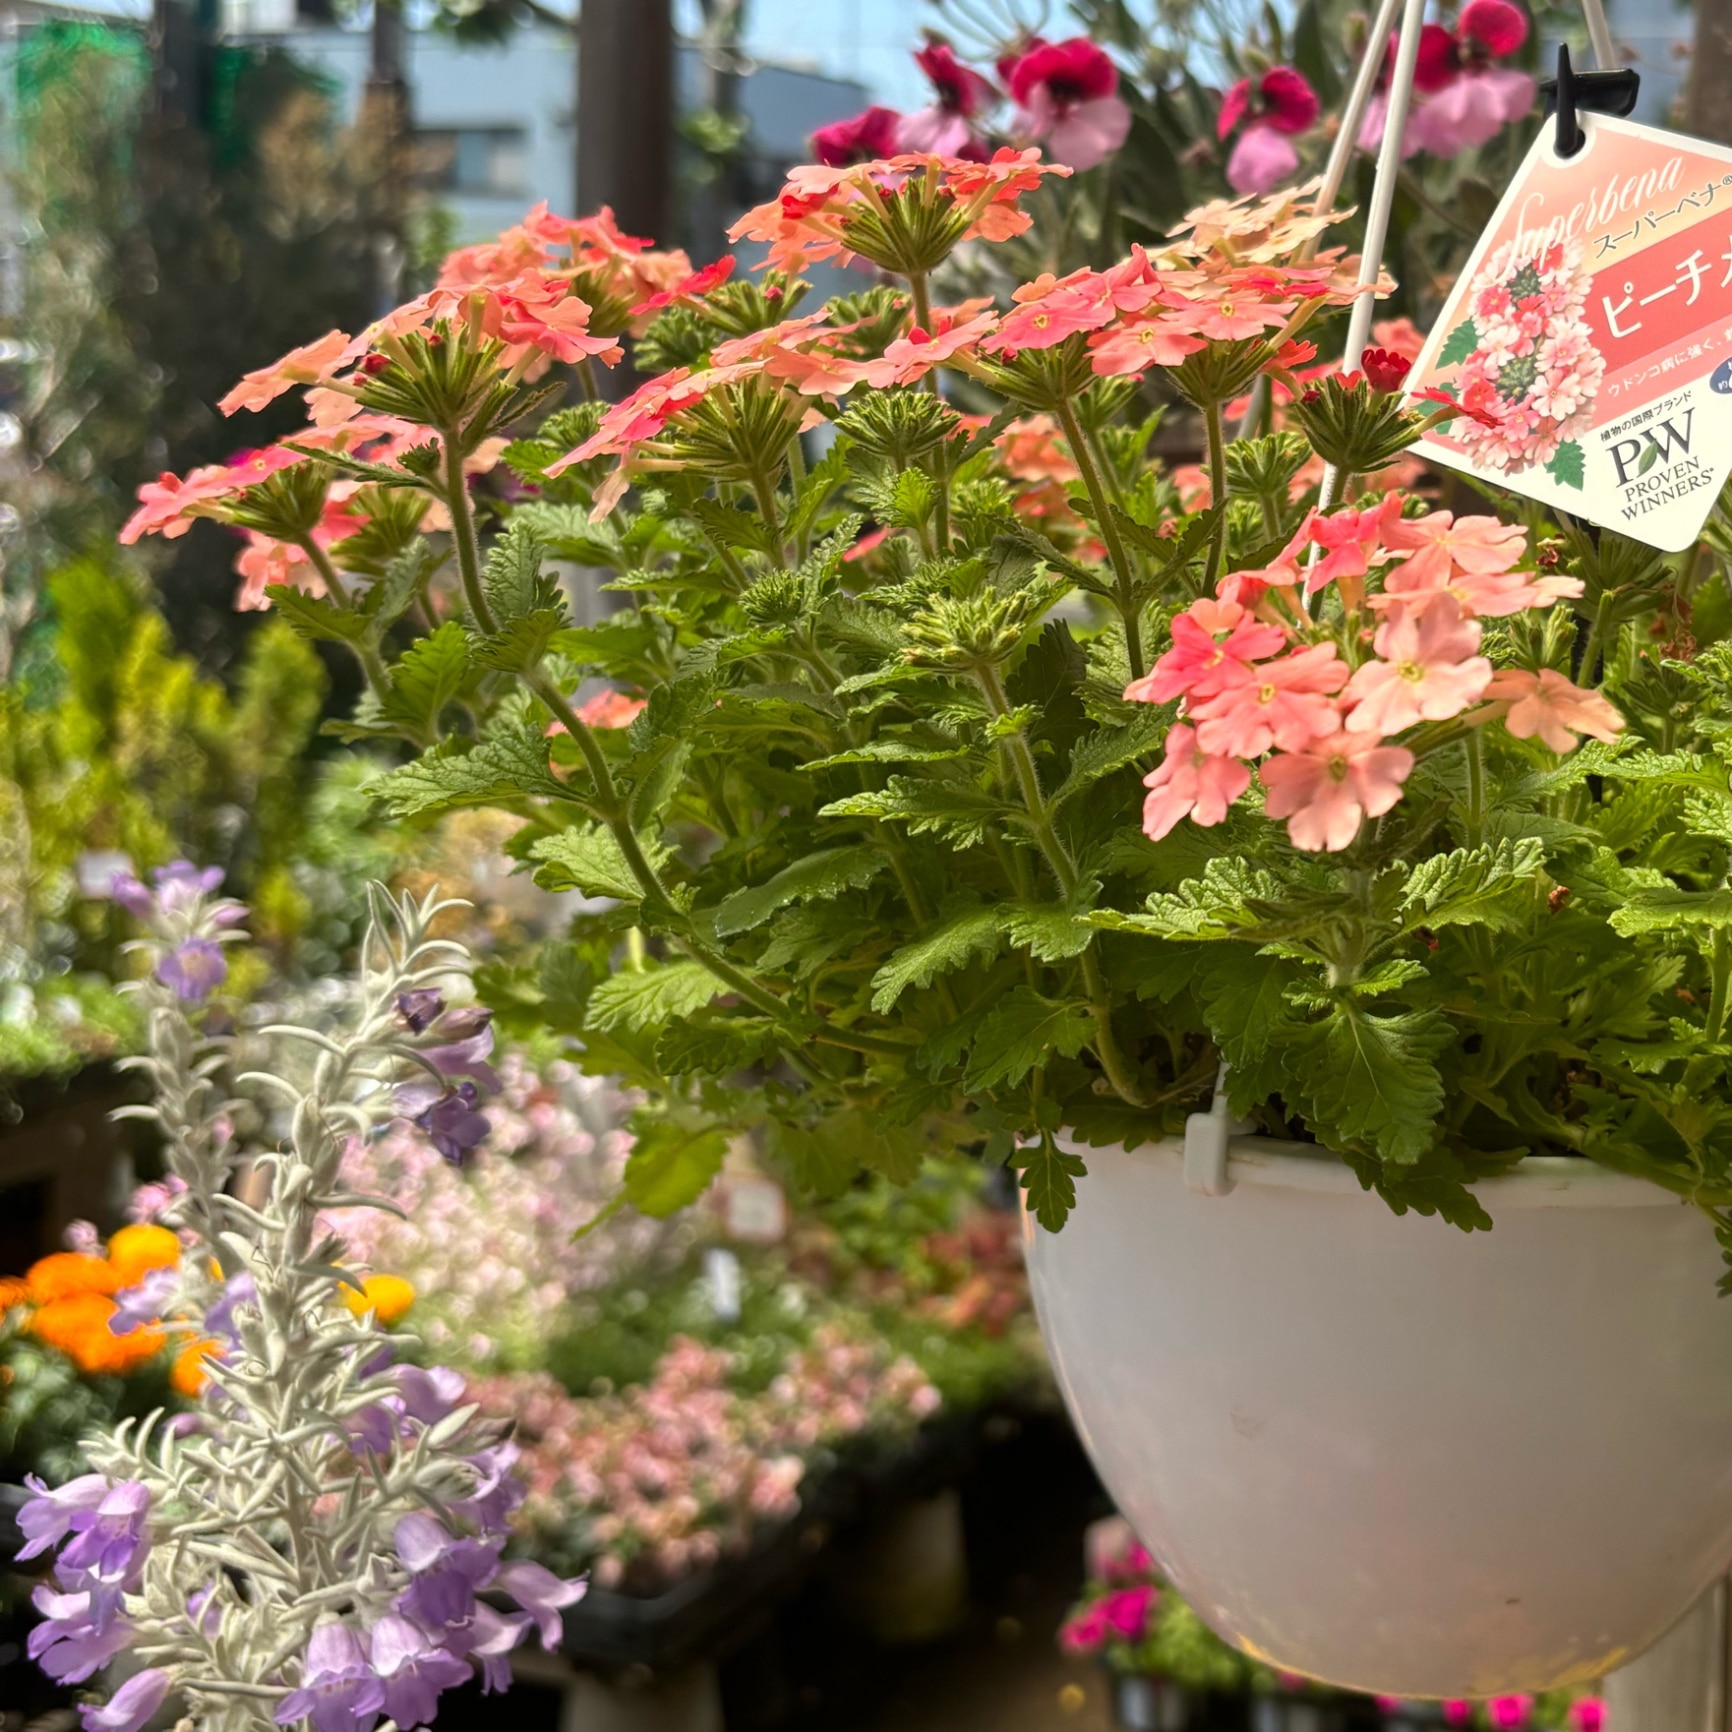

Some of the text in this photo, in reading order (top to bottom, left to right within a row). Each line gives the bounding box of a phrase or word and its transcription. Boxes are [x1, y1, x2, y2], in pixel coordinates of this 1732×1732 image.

[1471, 157, 1685, 288] Superbena
[1600, 390, 1692, 442] 植物の国際ブランド
[1605, 406, 1695, 488] PW
[1624, 455, 1700, 503] PROVEN
